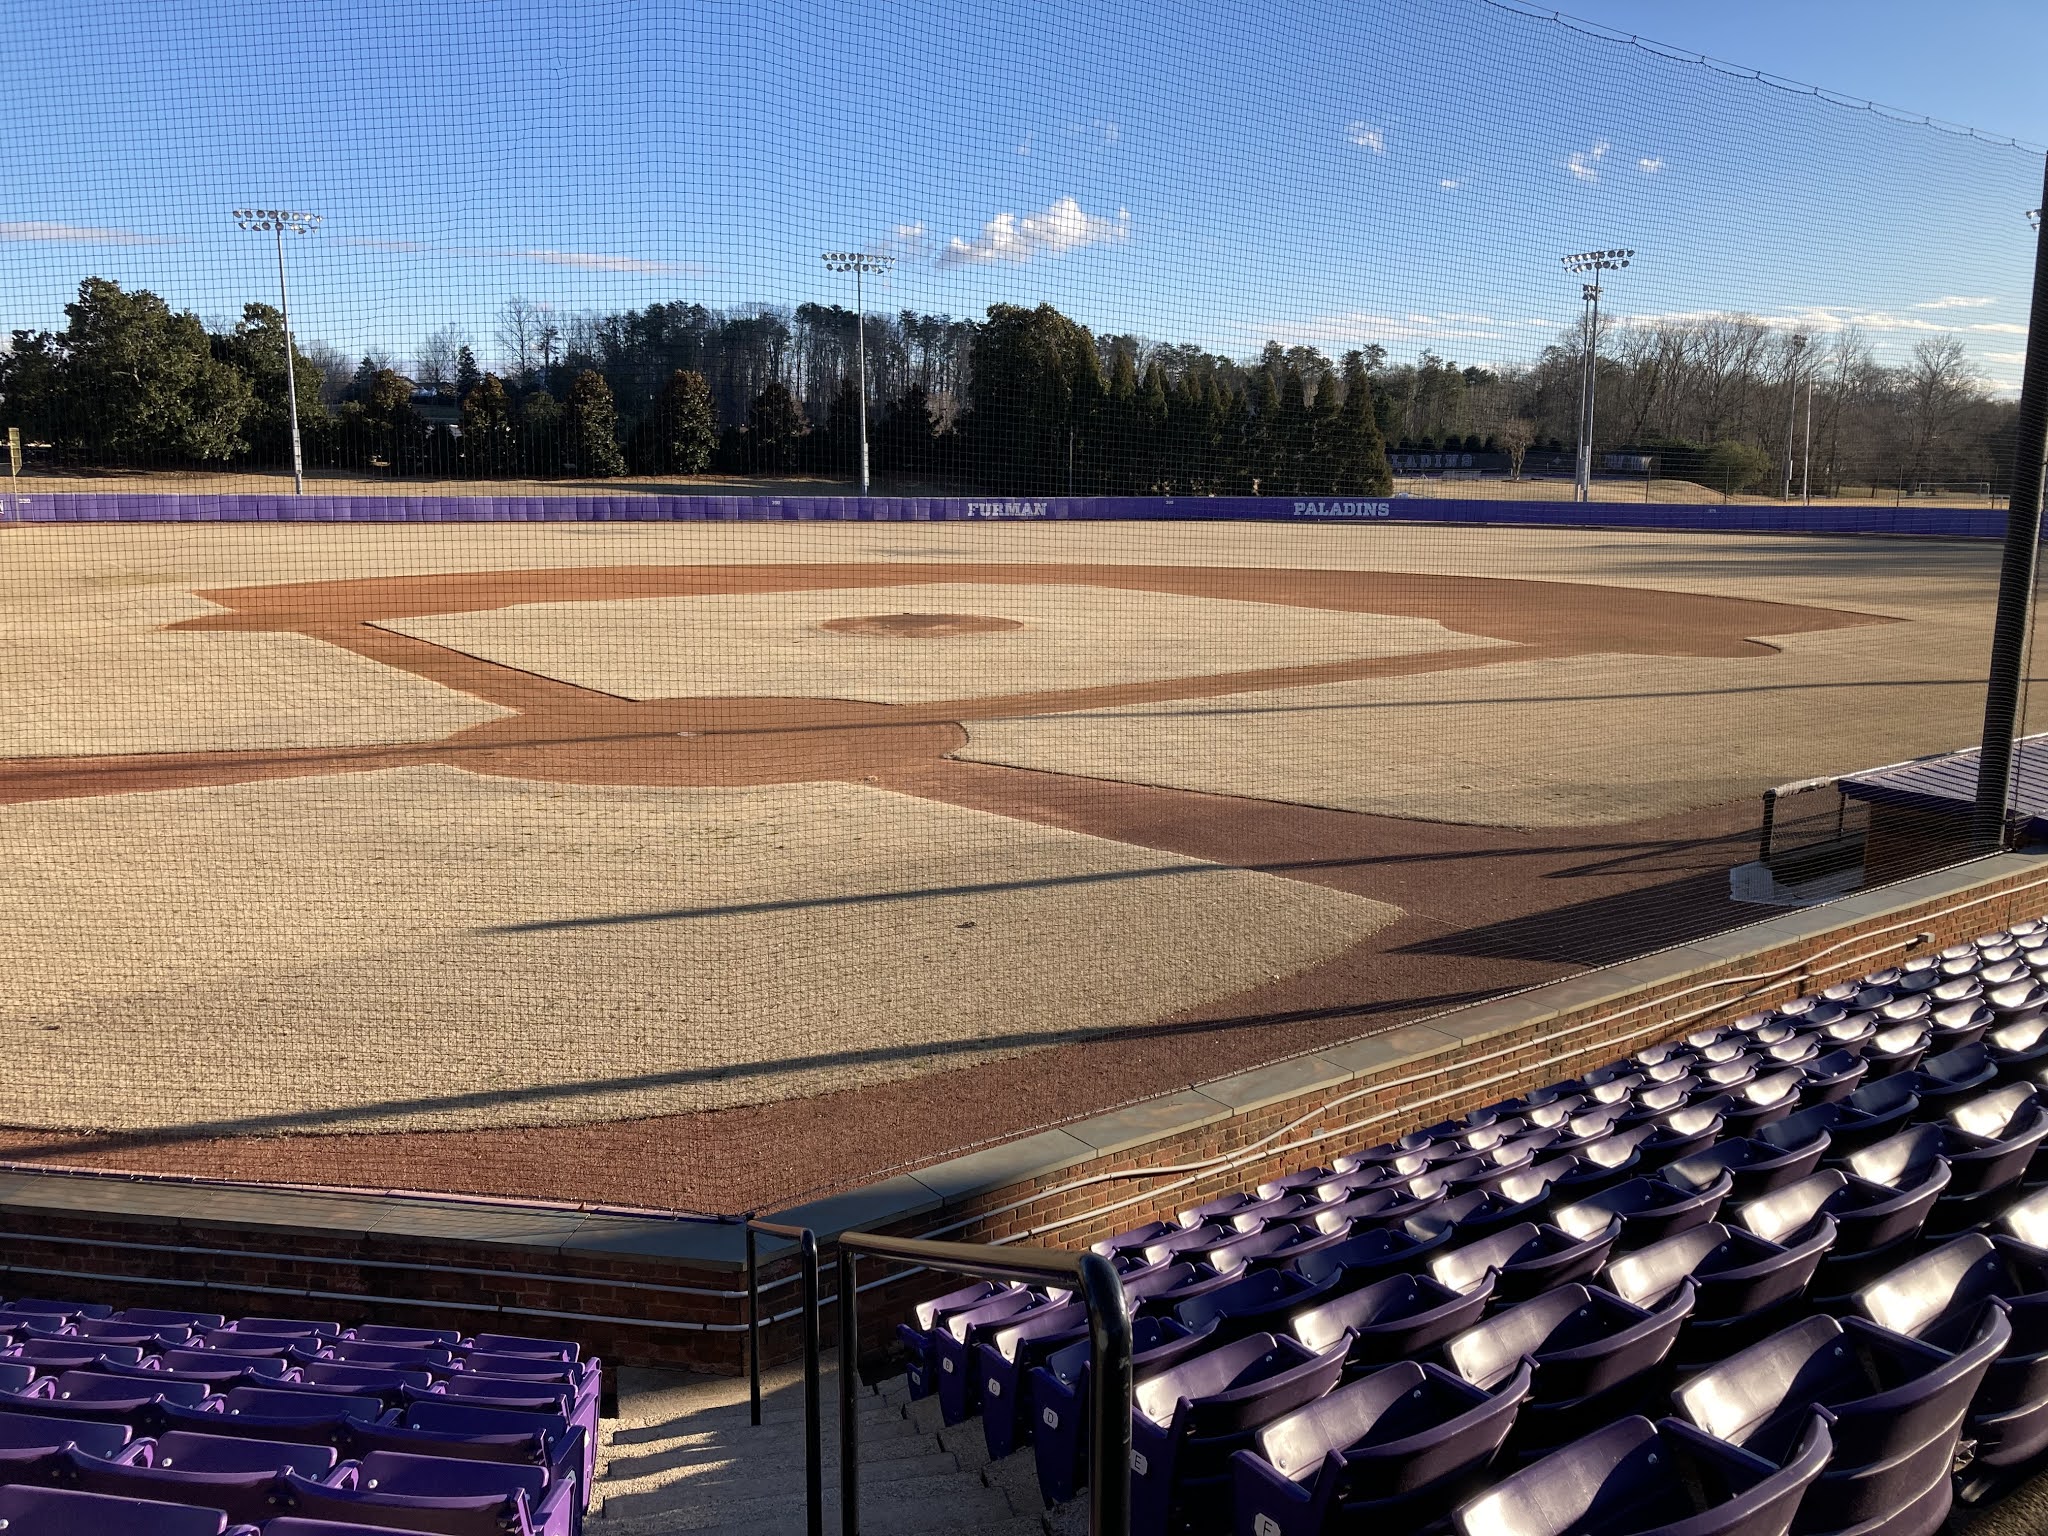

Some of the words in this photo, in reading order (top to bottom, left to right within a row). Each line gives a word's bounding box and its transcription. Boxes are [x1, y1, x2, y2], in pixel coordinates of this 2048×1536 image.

[967, 502, 1047, 517] FURMAN
[1293, 502, 1390, 517] PALADINS
[1134, 1454, 1142, 1470] E
[1262, 1520, 1273, 1536] F
